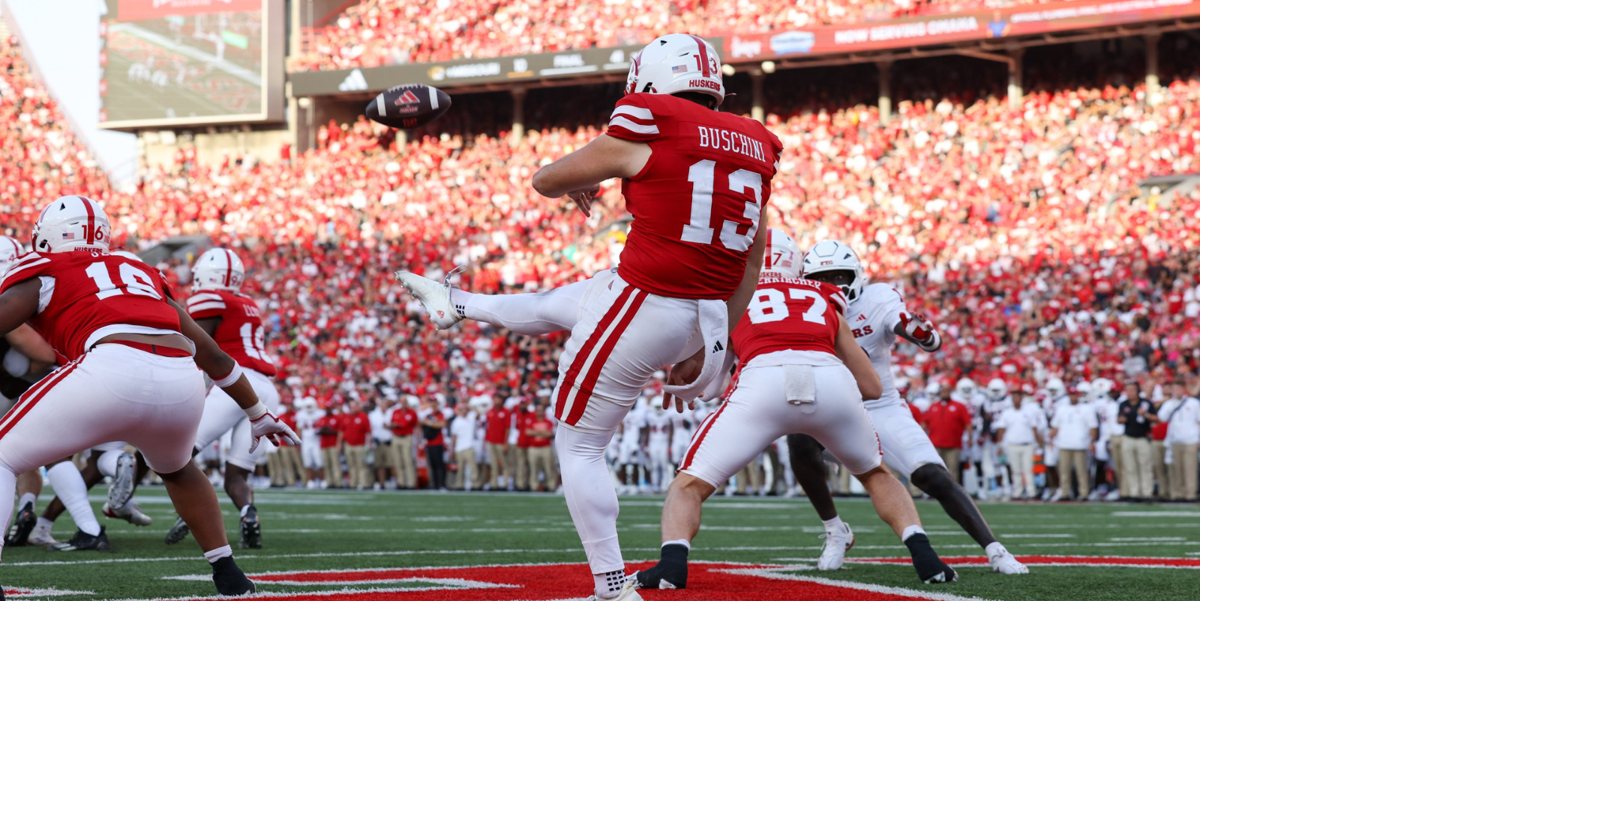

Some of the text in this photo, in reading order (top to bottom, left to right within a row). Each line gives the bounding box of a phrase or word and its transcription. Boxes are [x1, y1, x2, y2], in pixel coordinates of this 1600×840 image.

[693, 54, 718, 75] 13
[689, 79, 721, 91] HUSKERS
[698, 126, 766, 162] BUSCHINI
[681, 158, 763, 252] 13
[81, 224, 104, 241] 16
[773, 252, 783, 266] 7
[758, 276, 821, 291] ERKIRCHER
[759, 271, 782, 279] USKERS
[747, 288, 828, 326] 87
